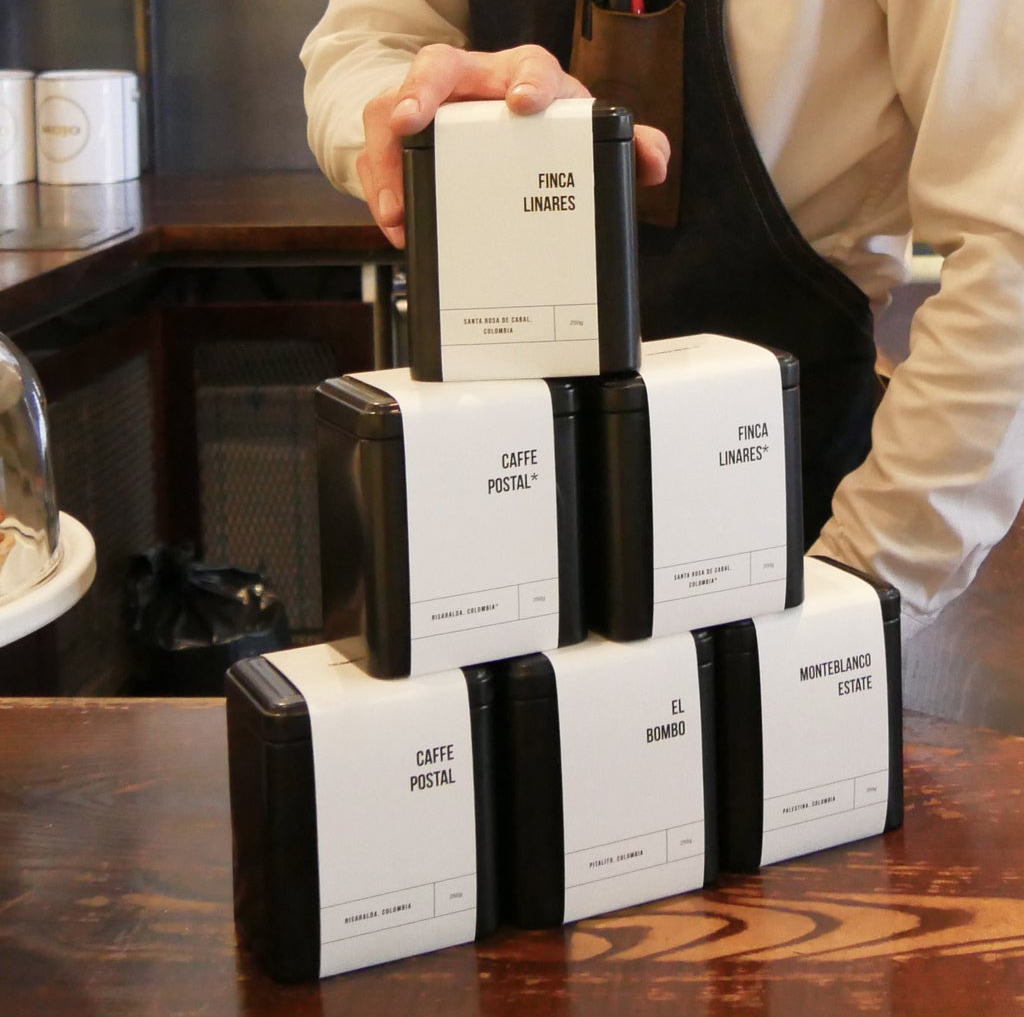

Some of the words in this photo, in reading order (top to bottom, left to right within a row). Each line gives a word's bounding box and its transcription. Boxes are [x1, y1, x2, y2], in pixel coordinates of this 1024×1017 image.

[538, 172, 575, 189] FINCA
[523, 195, 576, 212] LINARES
[483, 327, 513, 335] COLOMBIA
[738, 422, 769, 441] FINCA
[502, 449, 538, 469] CAFFE
[800, 652, 871, 682] MONTEBLANCO
[838, 675, 872, 696] ESTATE
[671, 698, 685, 715] EL
[646, 720, 685, 743] BOMBO
[416, 744, 454, 767] CAFFE
[410, 768, 456, 792] POSTAL
[812, 796, 836, 807] COLOMBIA
[616, 849, 643, 862] COLOMBIA
[381, 903, 412, 916] COLOMBIA
